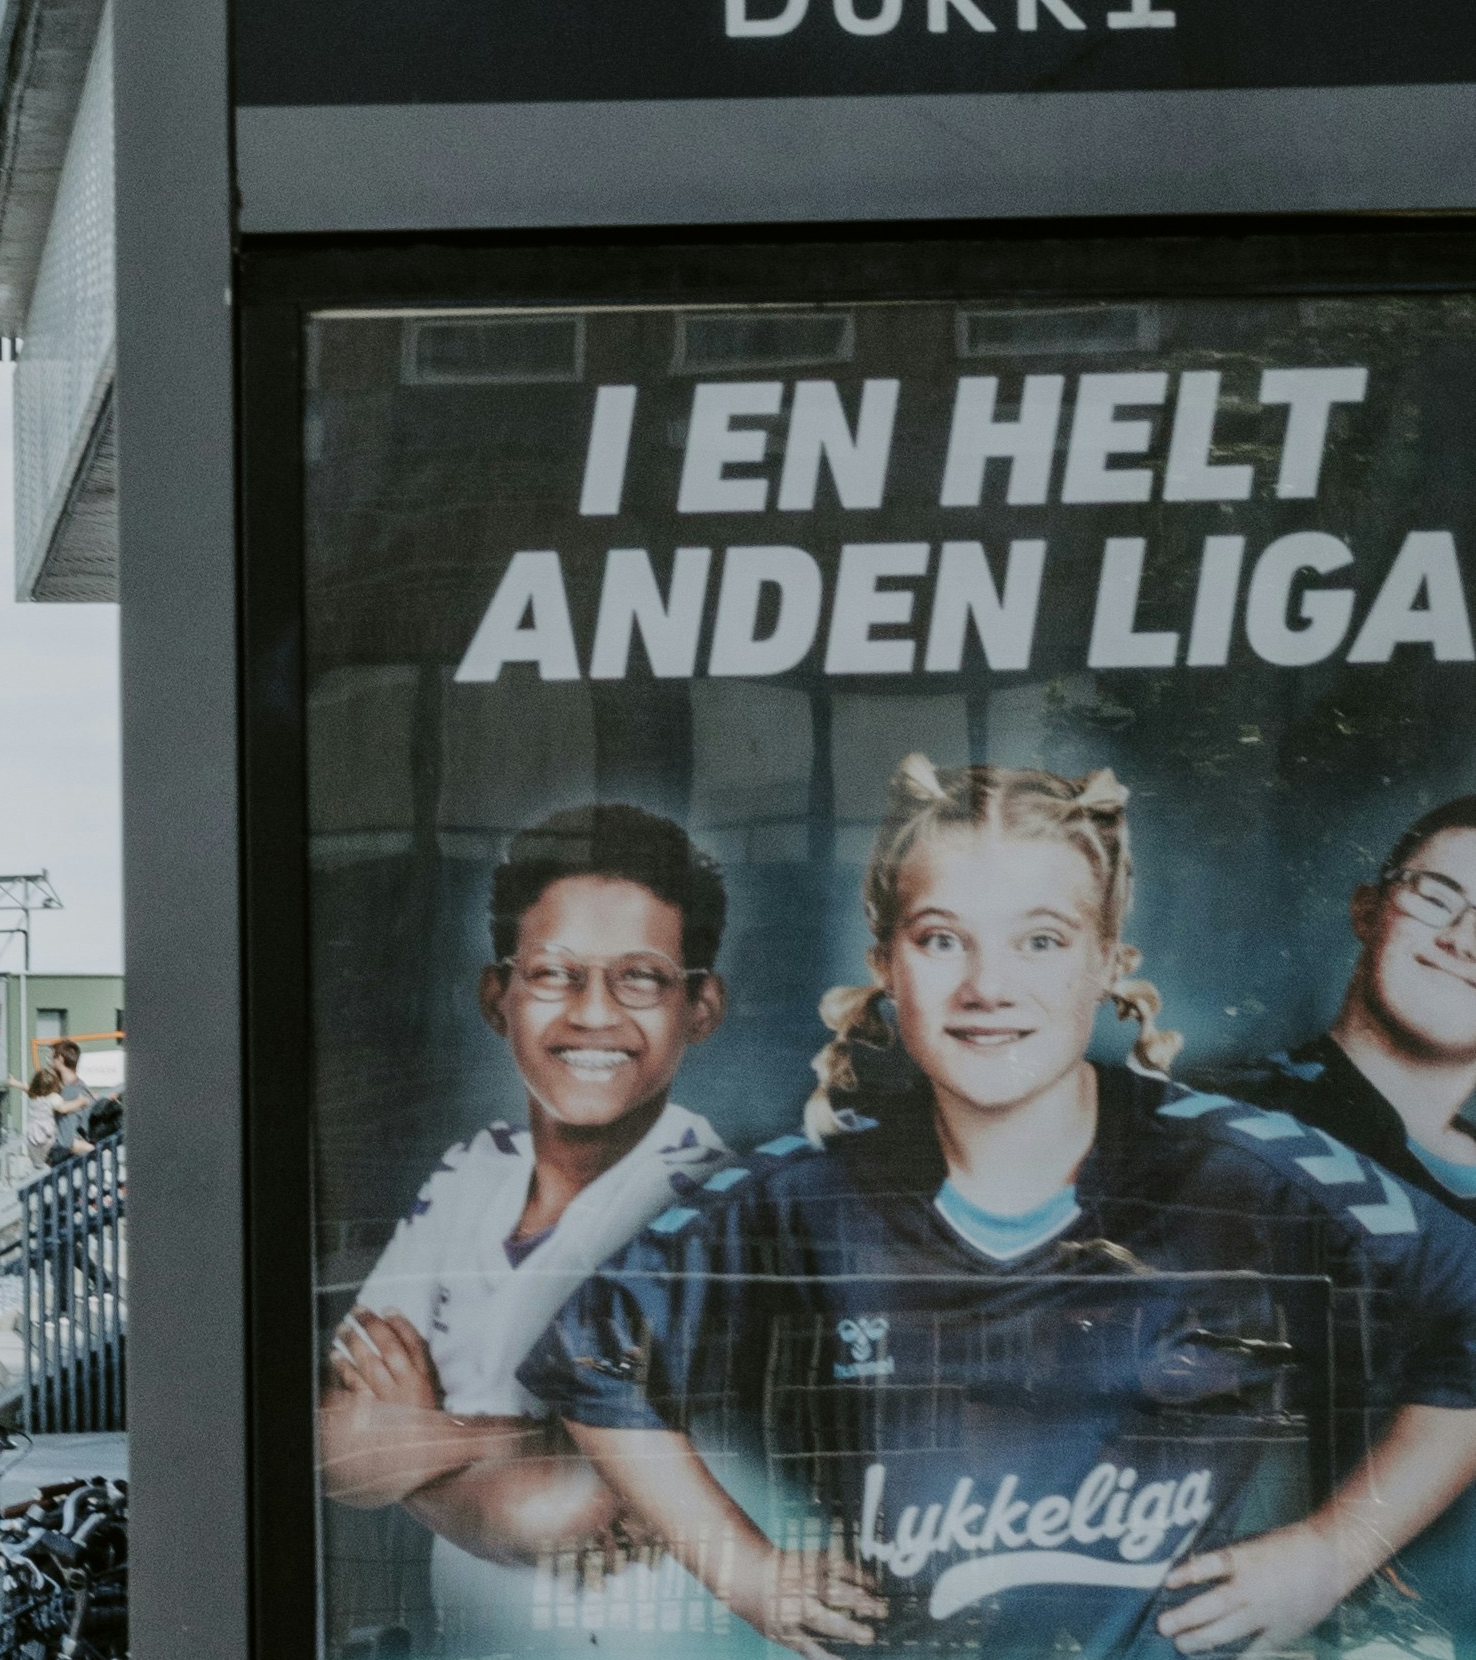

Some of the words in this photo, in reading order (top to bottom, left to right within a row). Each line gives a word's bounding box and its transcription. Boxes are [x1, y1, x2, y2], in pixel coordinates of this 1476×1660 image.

[579, 384, 637, 516] I
[676, 378, 901, 514] EN
[939, 367, 1368, 508] HELT
[453, 539, 1048, 683] ANDEN
[1087, 530, 1476, 669] LIGA
[860, 1462, 1213, 1579] Lykkeliga
